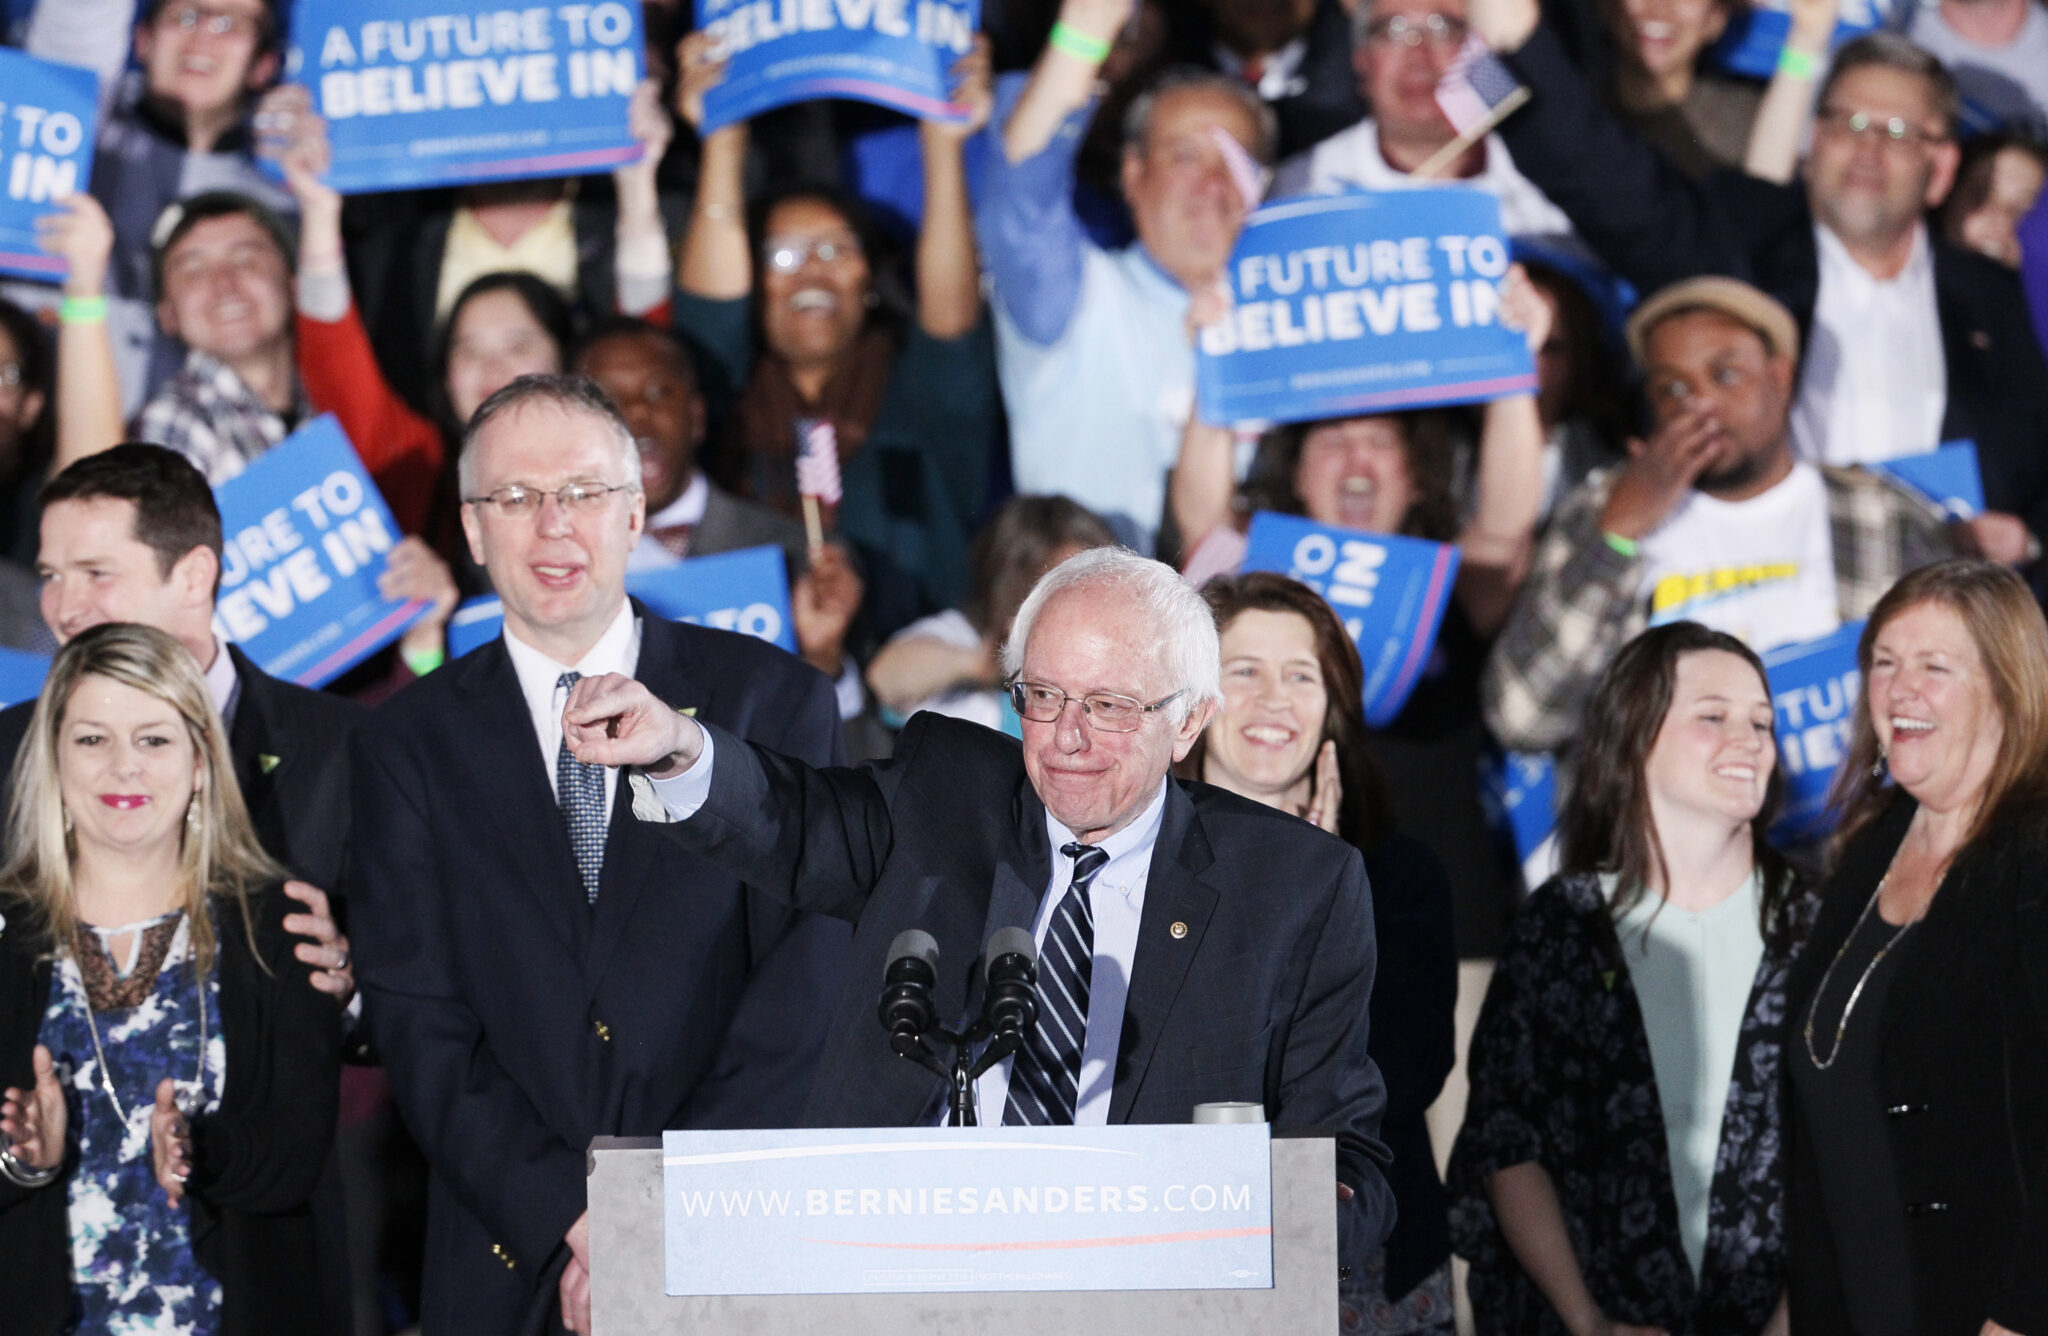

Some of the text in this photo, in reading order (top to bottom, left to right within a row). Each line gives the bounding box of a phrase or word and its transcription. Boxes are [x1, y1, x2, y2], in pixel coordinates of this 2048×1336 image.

[320, 2, 633, 69] A FUTURE TO
[321, 48, 637, 119] BELIEVE IN
[13, 104, 83, 156] TO
[8, 152, 78, 204] IN
[1239, 234, 1508, 299] FUTURE TO
[292, 470, 363, 530] TO
[321, 507, 392, 577] IN
[1327, 540, 1388, 608] IN
[681, 1184, 1251, 1218] WWW.BERNIESANDERS.COM
